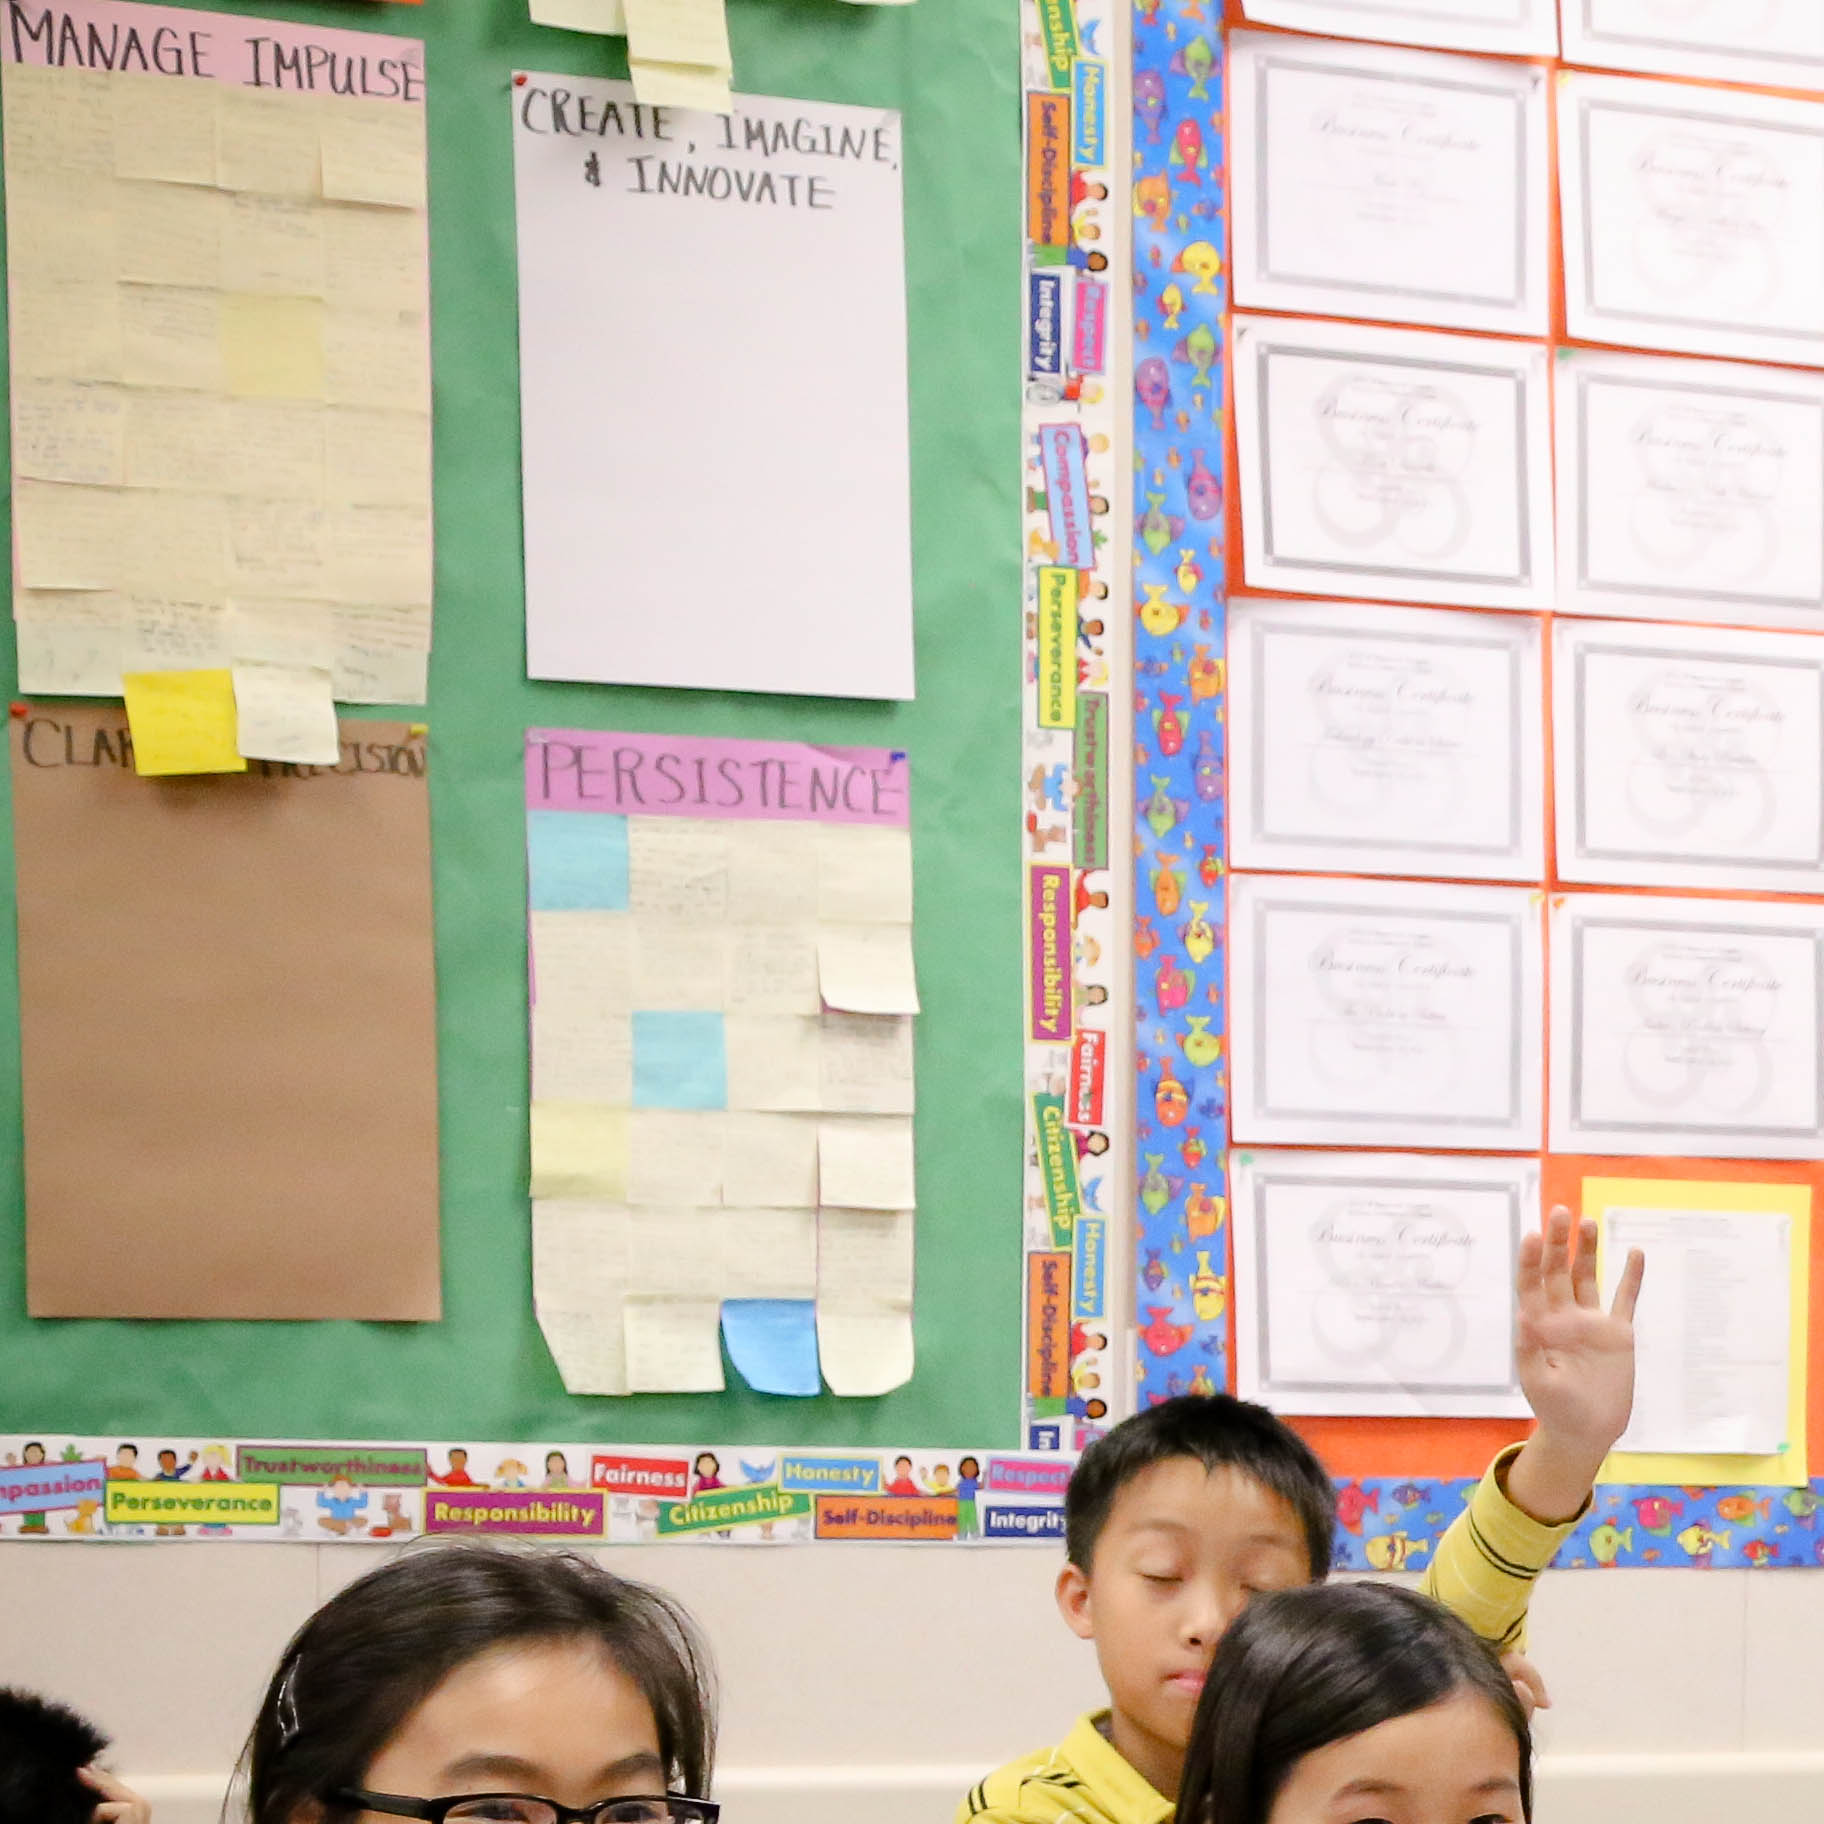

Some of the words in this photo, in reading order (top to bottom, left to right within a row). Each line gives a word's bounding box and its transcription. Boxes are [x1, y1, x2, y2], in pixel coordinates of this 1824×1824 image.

[10, 1, 215, 77] MANAGE
[243, 37, 424, 100] IMPULSE
[1080, 64, 1100, 161] Honesty
[626, 155, 836, 210] INNOVATE
[1033, 279, 1056, 370] Integrity
[1053, 430, 1080, 564] Compassion
[1049, 574, 1067, 723] Perseverance
[531, 741, 903, 816] PERSISTENCE
[1037, 875, 1060, 1033] Responsibility
[1075, 1030, 1100, 1122] Fairness
[1042, 1105, 1070, 1231] Citizenship
[1080, 1222, 1100, 1314] Honesty
[1039, 1260, 1057, 1396] Self-Discipline
[113, 1491, 273, 1513] Perseverance
[245, 1454, 423, 1477] Trustworthiness
[594, 1463, 687, 1488] Fairness
[669, 1491, 794, 1526] Citizenship
[785, 1462, 874, 1483] Honesty
[434, 1502, 596, 1528] Responsibility
[823, 1507, 957, 1530] Self-Discipline
